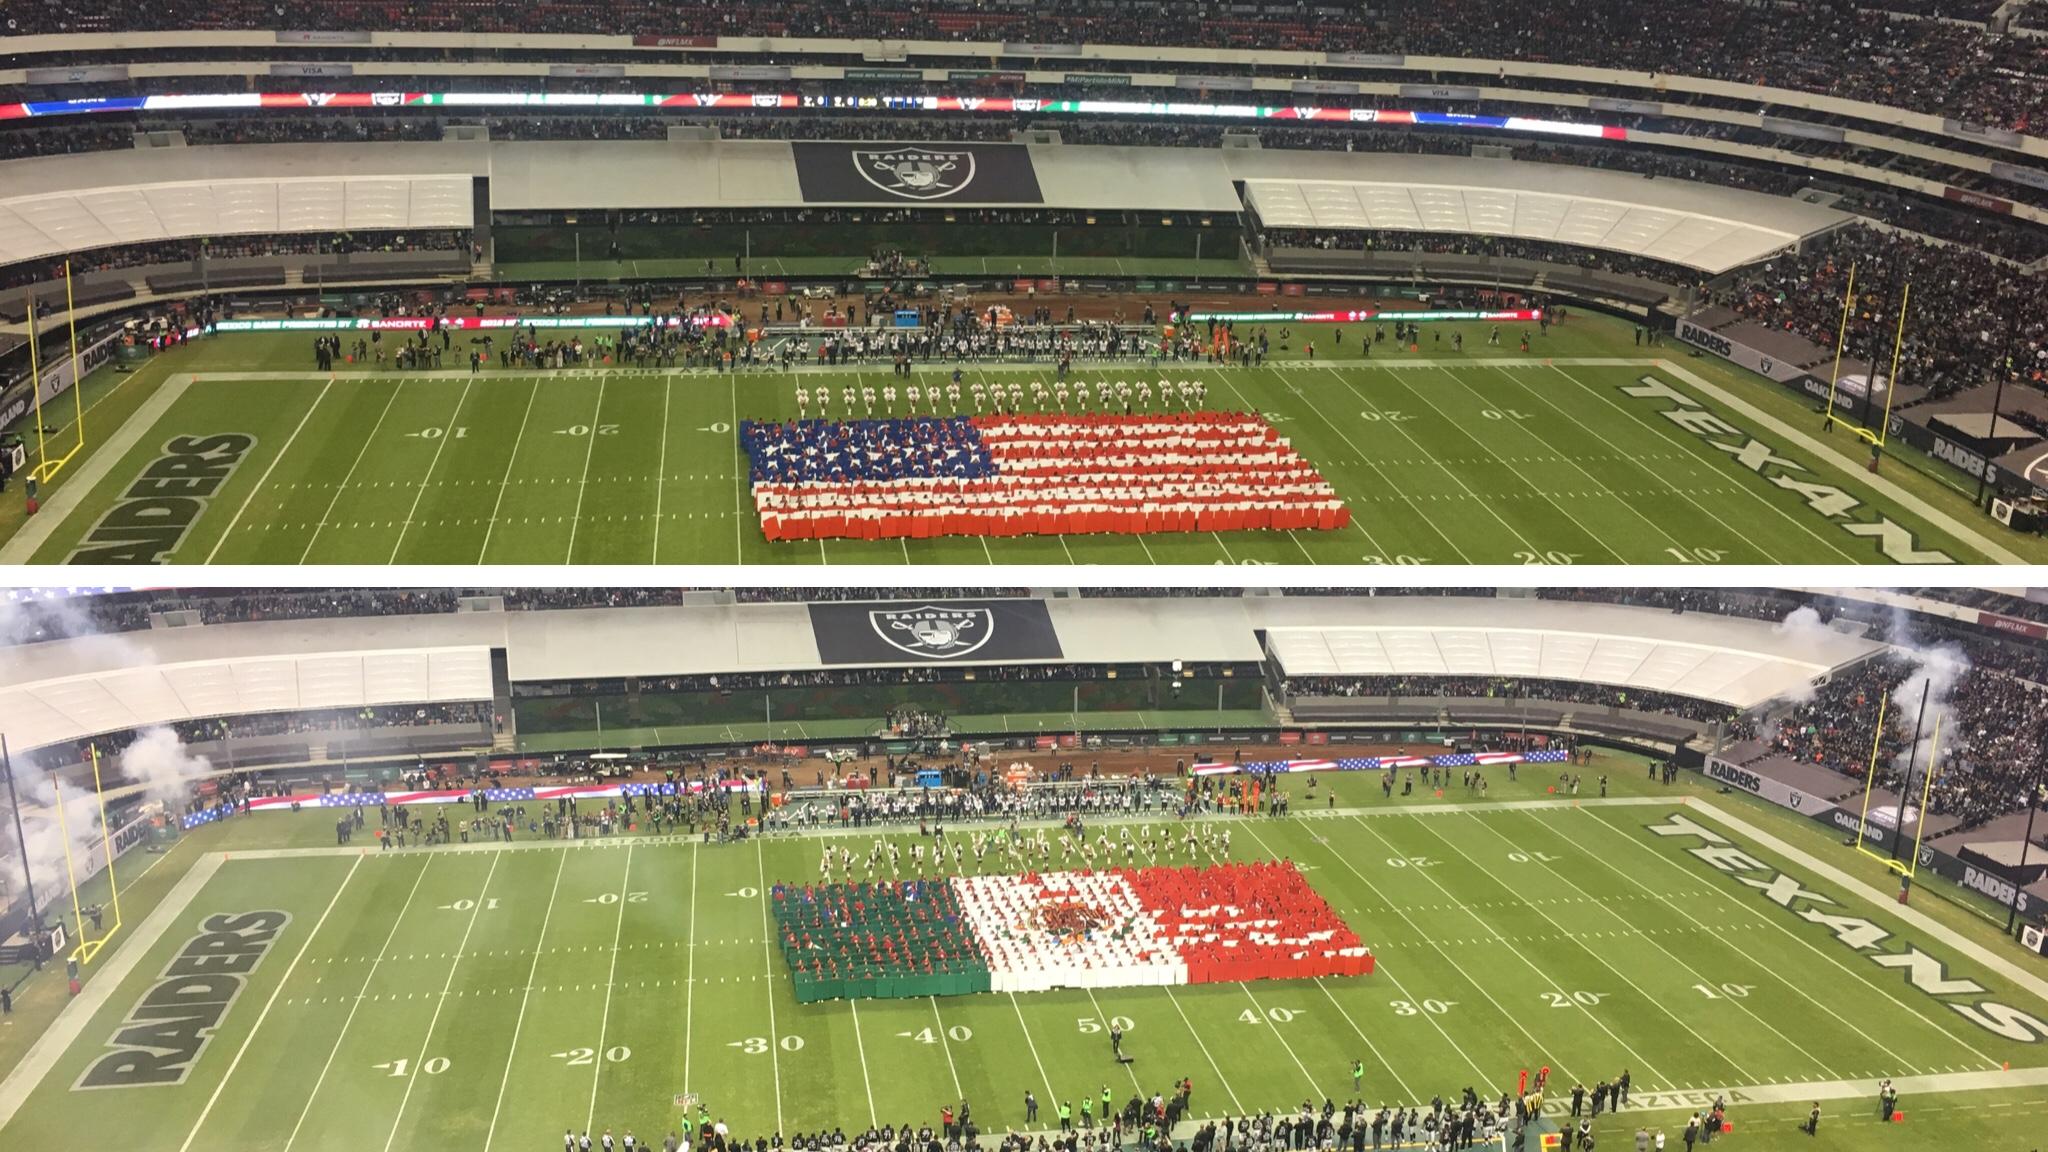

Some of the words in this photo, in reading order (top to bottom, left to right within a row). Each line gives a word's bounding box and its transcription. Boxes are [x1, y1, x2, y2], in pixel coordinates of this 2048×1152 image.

[1432, 89, 1450, 97] VISA
[371, 320, 427, 328] BANORTE
[1681, 324, 1732, 357] RAIDERS
[1933, 436, 1998, 484] RAIDERS
[1665, 547, 1721, 563] 10
[886, 611, 977, 619] RAIDERS
[1710, 760, 1761, 793] RAIDERS
[1834, 811, 1884, 842] OAKLAND
[1964, 866, 2029, 912] RAIDERS
[1644, 812, 2046, 1043] TEXANS
[71, 910, 293, 1090] RAIDERS
[1540, 990, 1601, 1008] 20
[1692, 983, 1750, 999] 10
[1238, 1006, 1296, 1025] 40
[1389, 999, 1449, 1016] 30
[1078, 1015, 1136, 1034] 50
[914, 1025, 973, 1044] 40
[742, 1035, 805, 1054] 30
[566, 1046, 632, 1066] 20
[387, 1056, 452, 1077] 10
[1623, 1088, 1755, 1112] AZTECA
